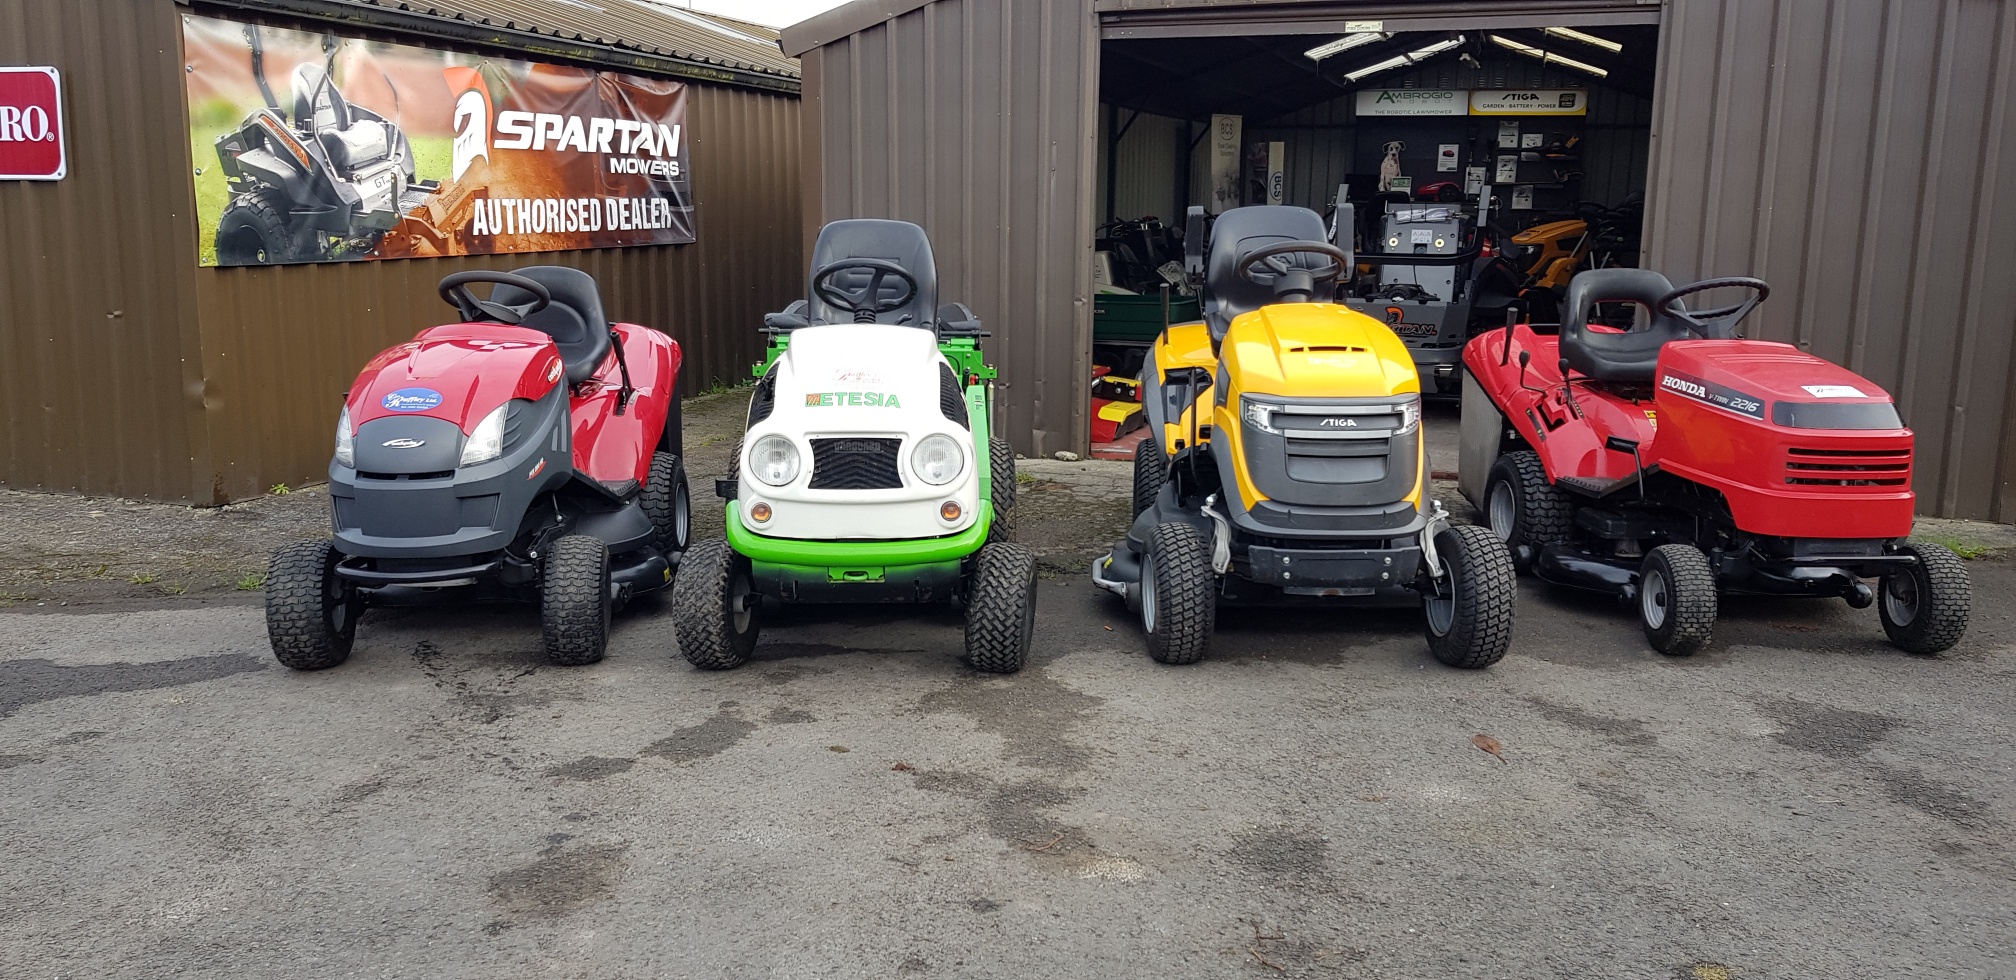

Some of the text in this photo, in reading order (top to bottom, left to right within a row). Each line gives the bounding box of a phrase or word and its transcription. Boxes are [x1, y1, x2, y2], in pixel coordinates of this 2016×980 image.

[1375, 91, 1453, 104] AMBROGIO
[493, 110, 681, 158] SPARTAN
[1220, 122, 1234, 135] BCS
[609, 157, 680, 176] MOWERS
[1274, 175, 1282, 198] BCS
[472, 197, 672, 236] AUTHORISED DEALER
[819, 391, 902, 409] ETESIA
[1661, 374, 1760, 412] HONDA V-TWIN 2216
[1319, 418, 1357, 427] STIGA
